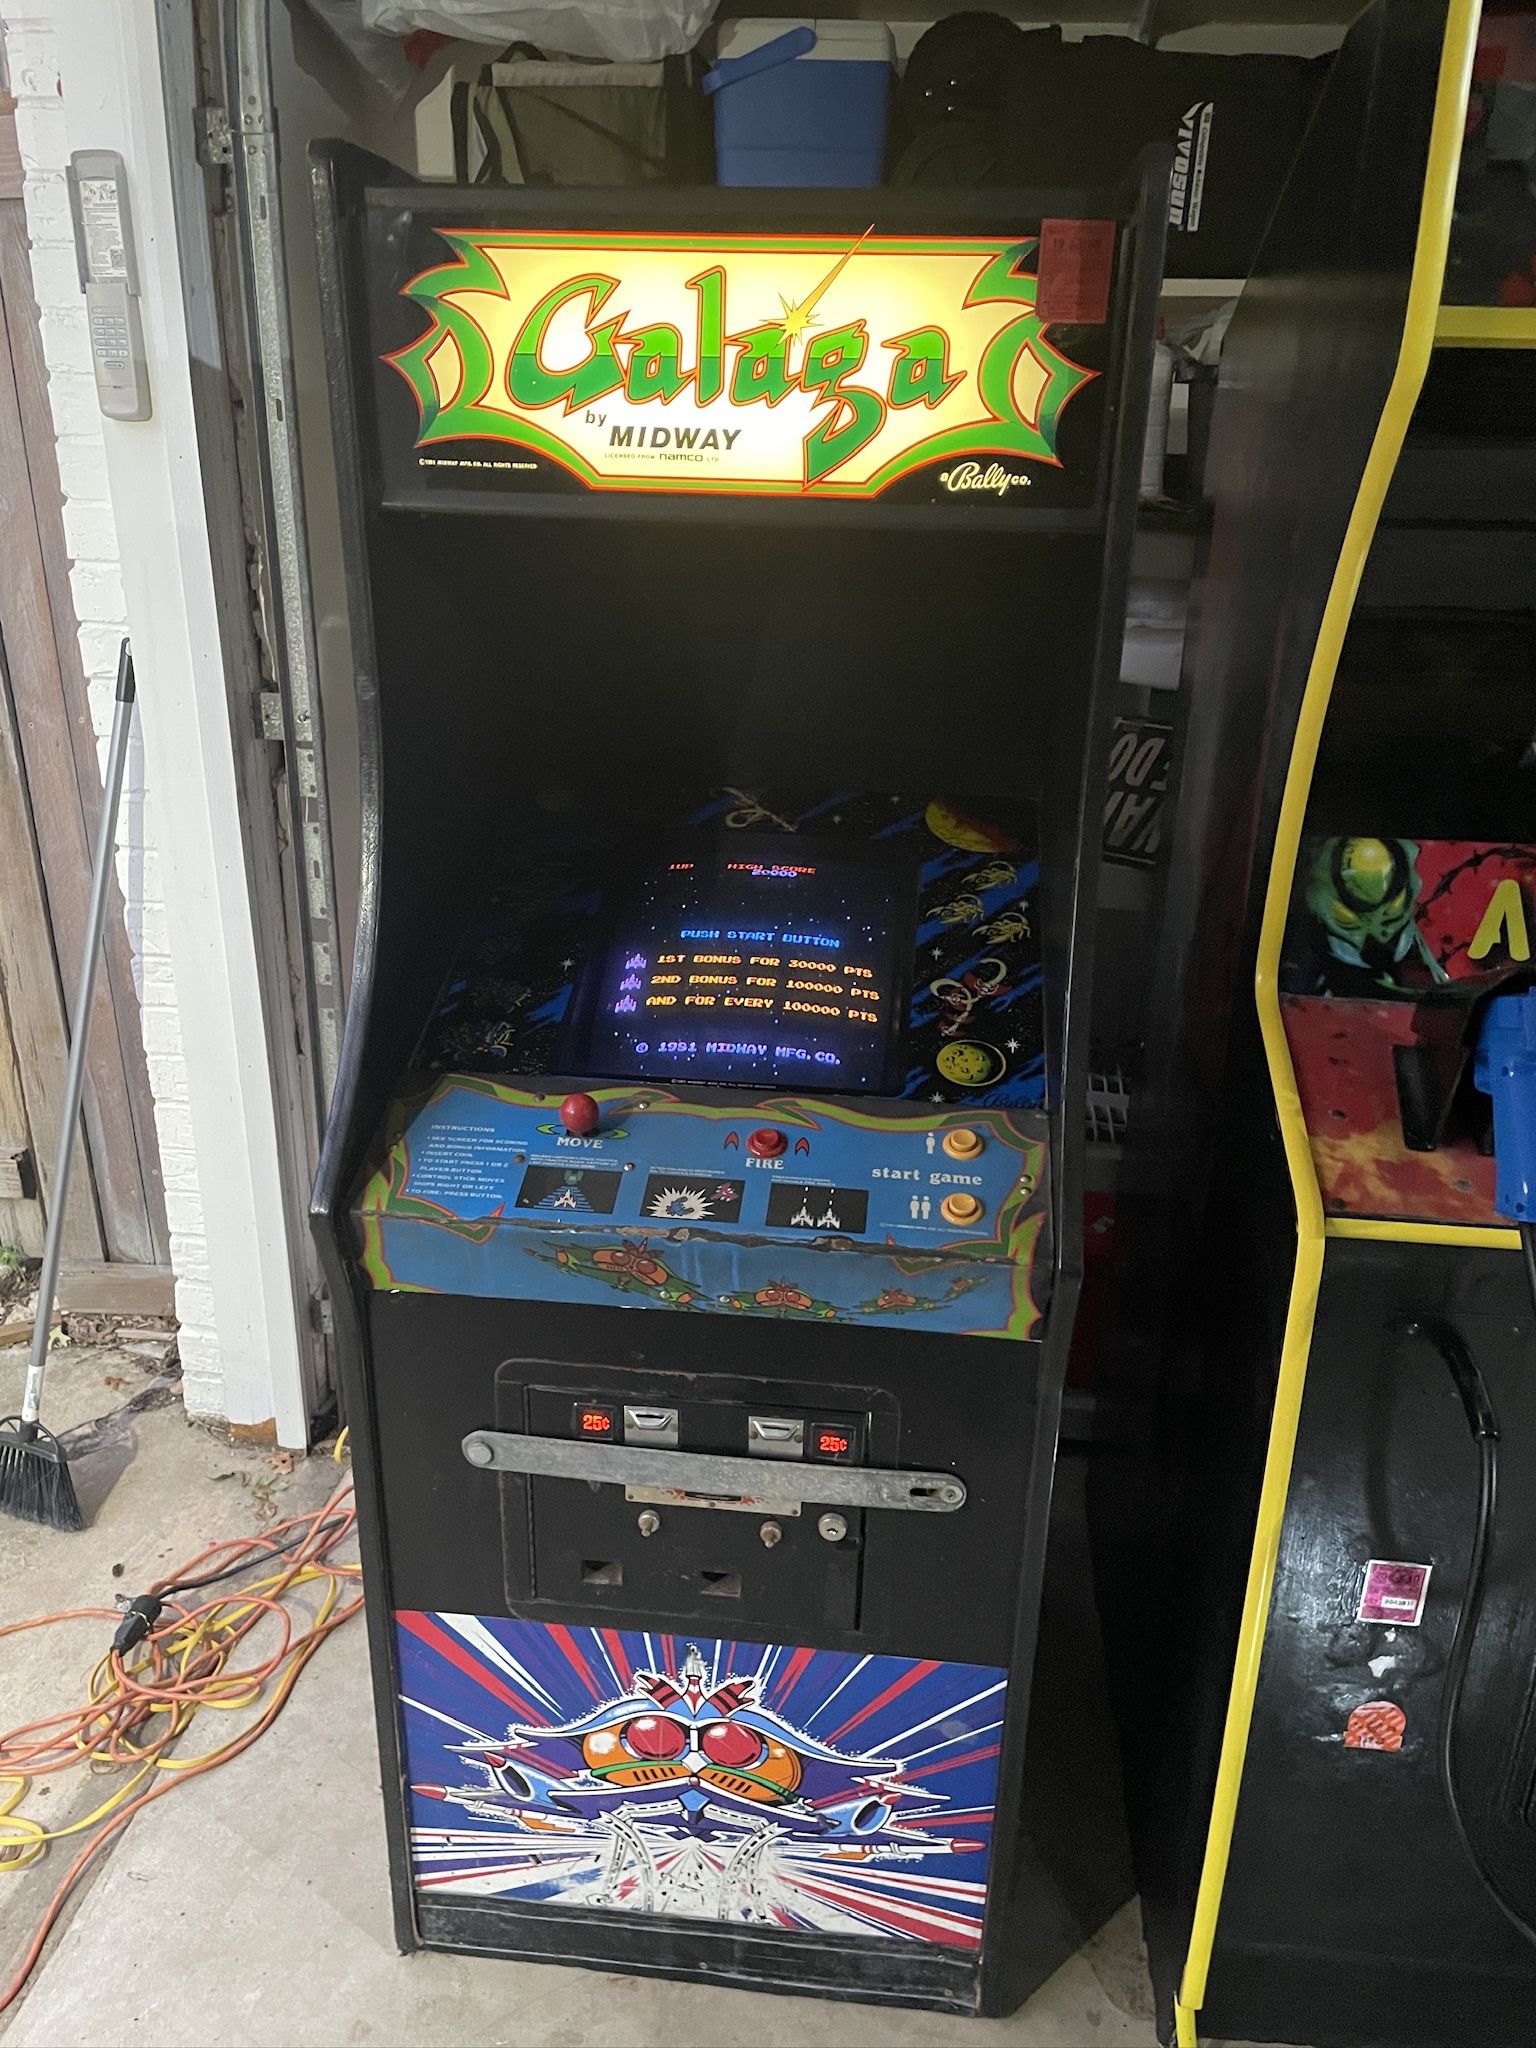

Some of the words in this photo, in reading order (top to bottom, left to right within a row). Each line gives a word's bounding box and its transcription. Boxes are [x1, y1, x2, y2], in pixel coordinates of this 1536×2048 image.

[507, 265, 968, 492] Galaga
[585, 409, 607, 427] by
[609, 425, 743, 450] MIDWAY
[659, 452, 704, 462] namco
[947, 461, 1012, 496] Bally
[727, 863, 764, 871] HIGH
[752, 869, 798, 878] 20000
[680, 929, 720, 940] PUSH
[727, 930, 775, 942] START
[782, 934, 841, 948] BUTTON
[657, 954, 687, 964] 1ST
[693, 954, 742, 965] BONUS
[749, 956, 781, 967] FOR
[788, 959, 837, 973] 30000
[843, 966, 874, 979] PTS
[650, 975, 682, 985] 2ND
[689, 975, 738, 985] BONUS
[746, 976, 777, 987] FOR
[786, 980, 844, 994] 100000
[850, 988, 880, 1001] PTS
[645, 995, 678, 1006] AND
[685, 995, 716, 1006] FOR
[724, 997, 774, 1009] EVERY
[783, 1001, 841, 1016] 100000
[848, 1009, 878, 1023] PTS
[657, 1041, 698, 1053] 1981
[705, 1042, 768, 1056] MIDWAY
[431, 1124, 495, 1133] INSTRUCTIONS
[472, 1145, 526, 1153] INFORMATION
[556, 1136, 603, 1150] MOVE
[745, 1157, 785, 1170] FIRE
[872, 1166, 920, 1181] start
[929, 1172, 983, 1186] game
[582, 1413, 611, 1432] 25¢
[819, 1435, 849, 1453] 25¢
